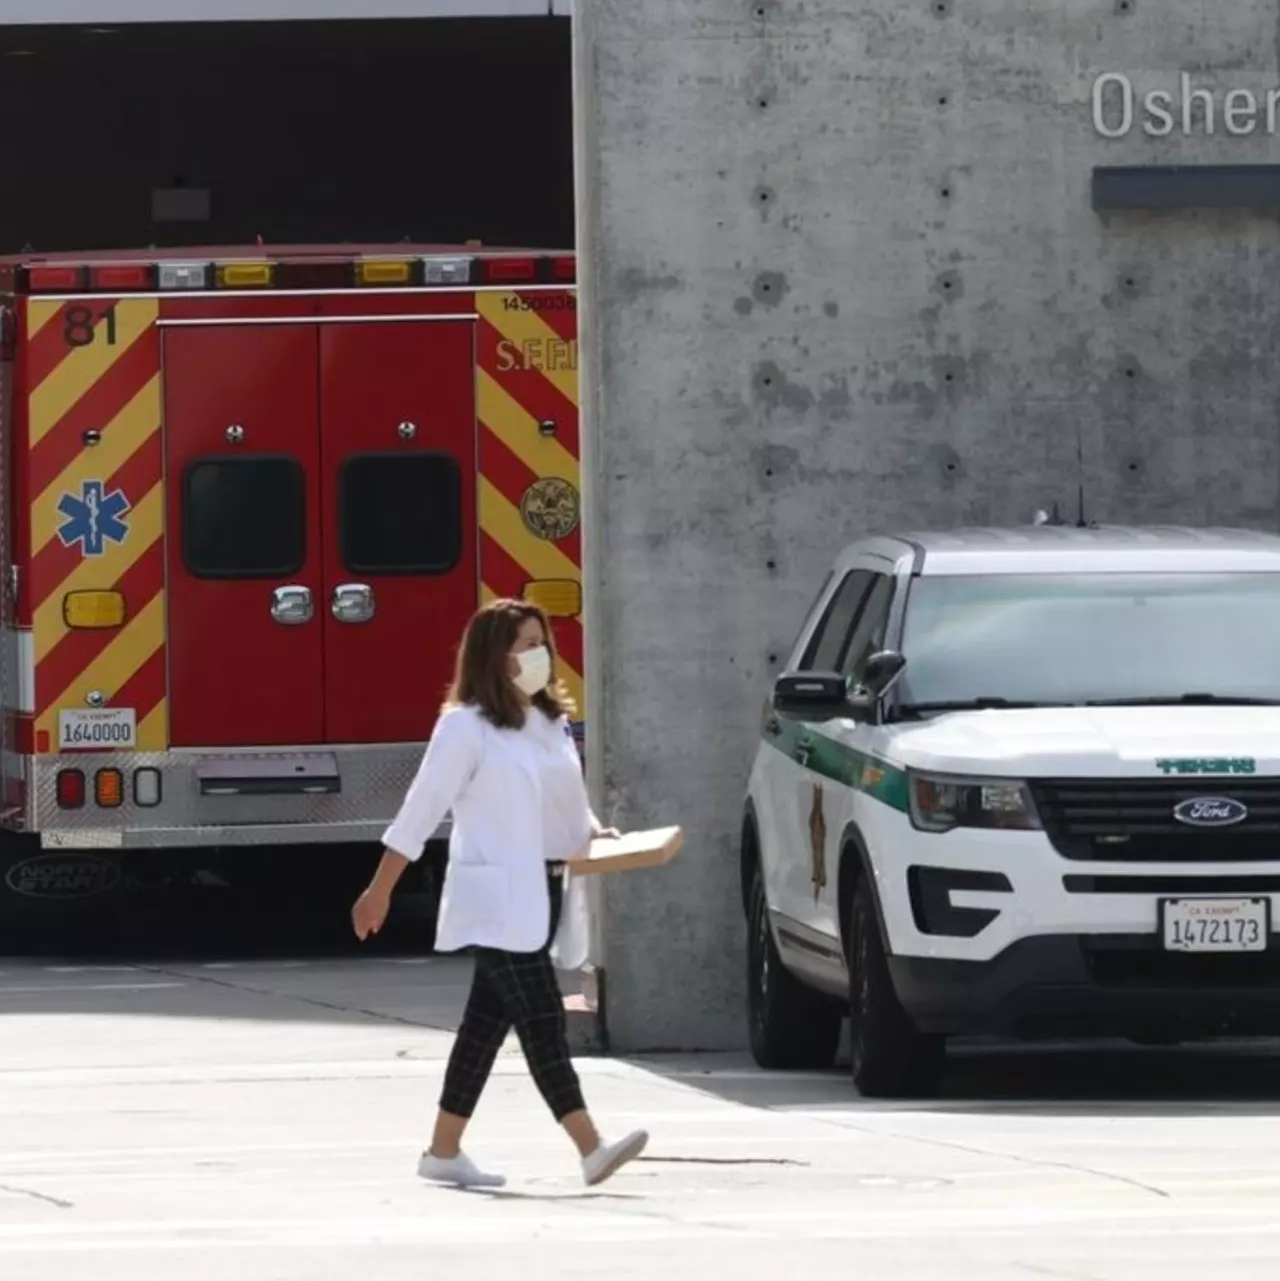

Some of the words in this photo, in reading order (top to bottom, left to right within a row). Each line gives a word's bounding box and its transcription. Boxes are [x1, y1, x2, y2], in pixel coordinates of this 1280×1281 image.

[64, 305, 116, 347] 81
[63, 722, 131, 743] 1640000
[1189, 801, 1231, 818] Ford
[1172, 918, 1259, 944] 1472173
